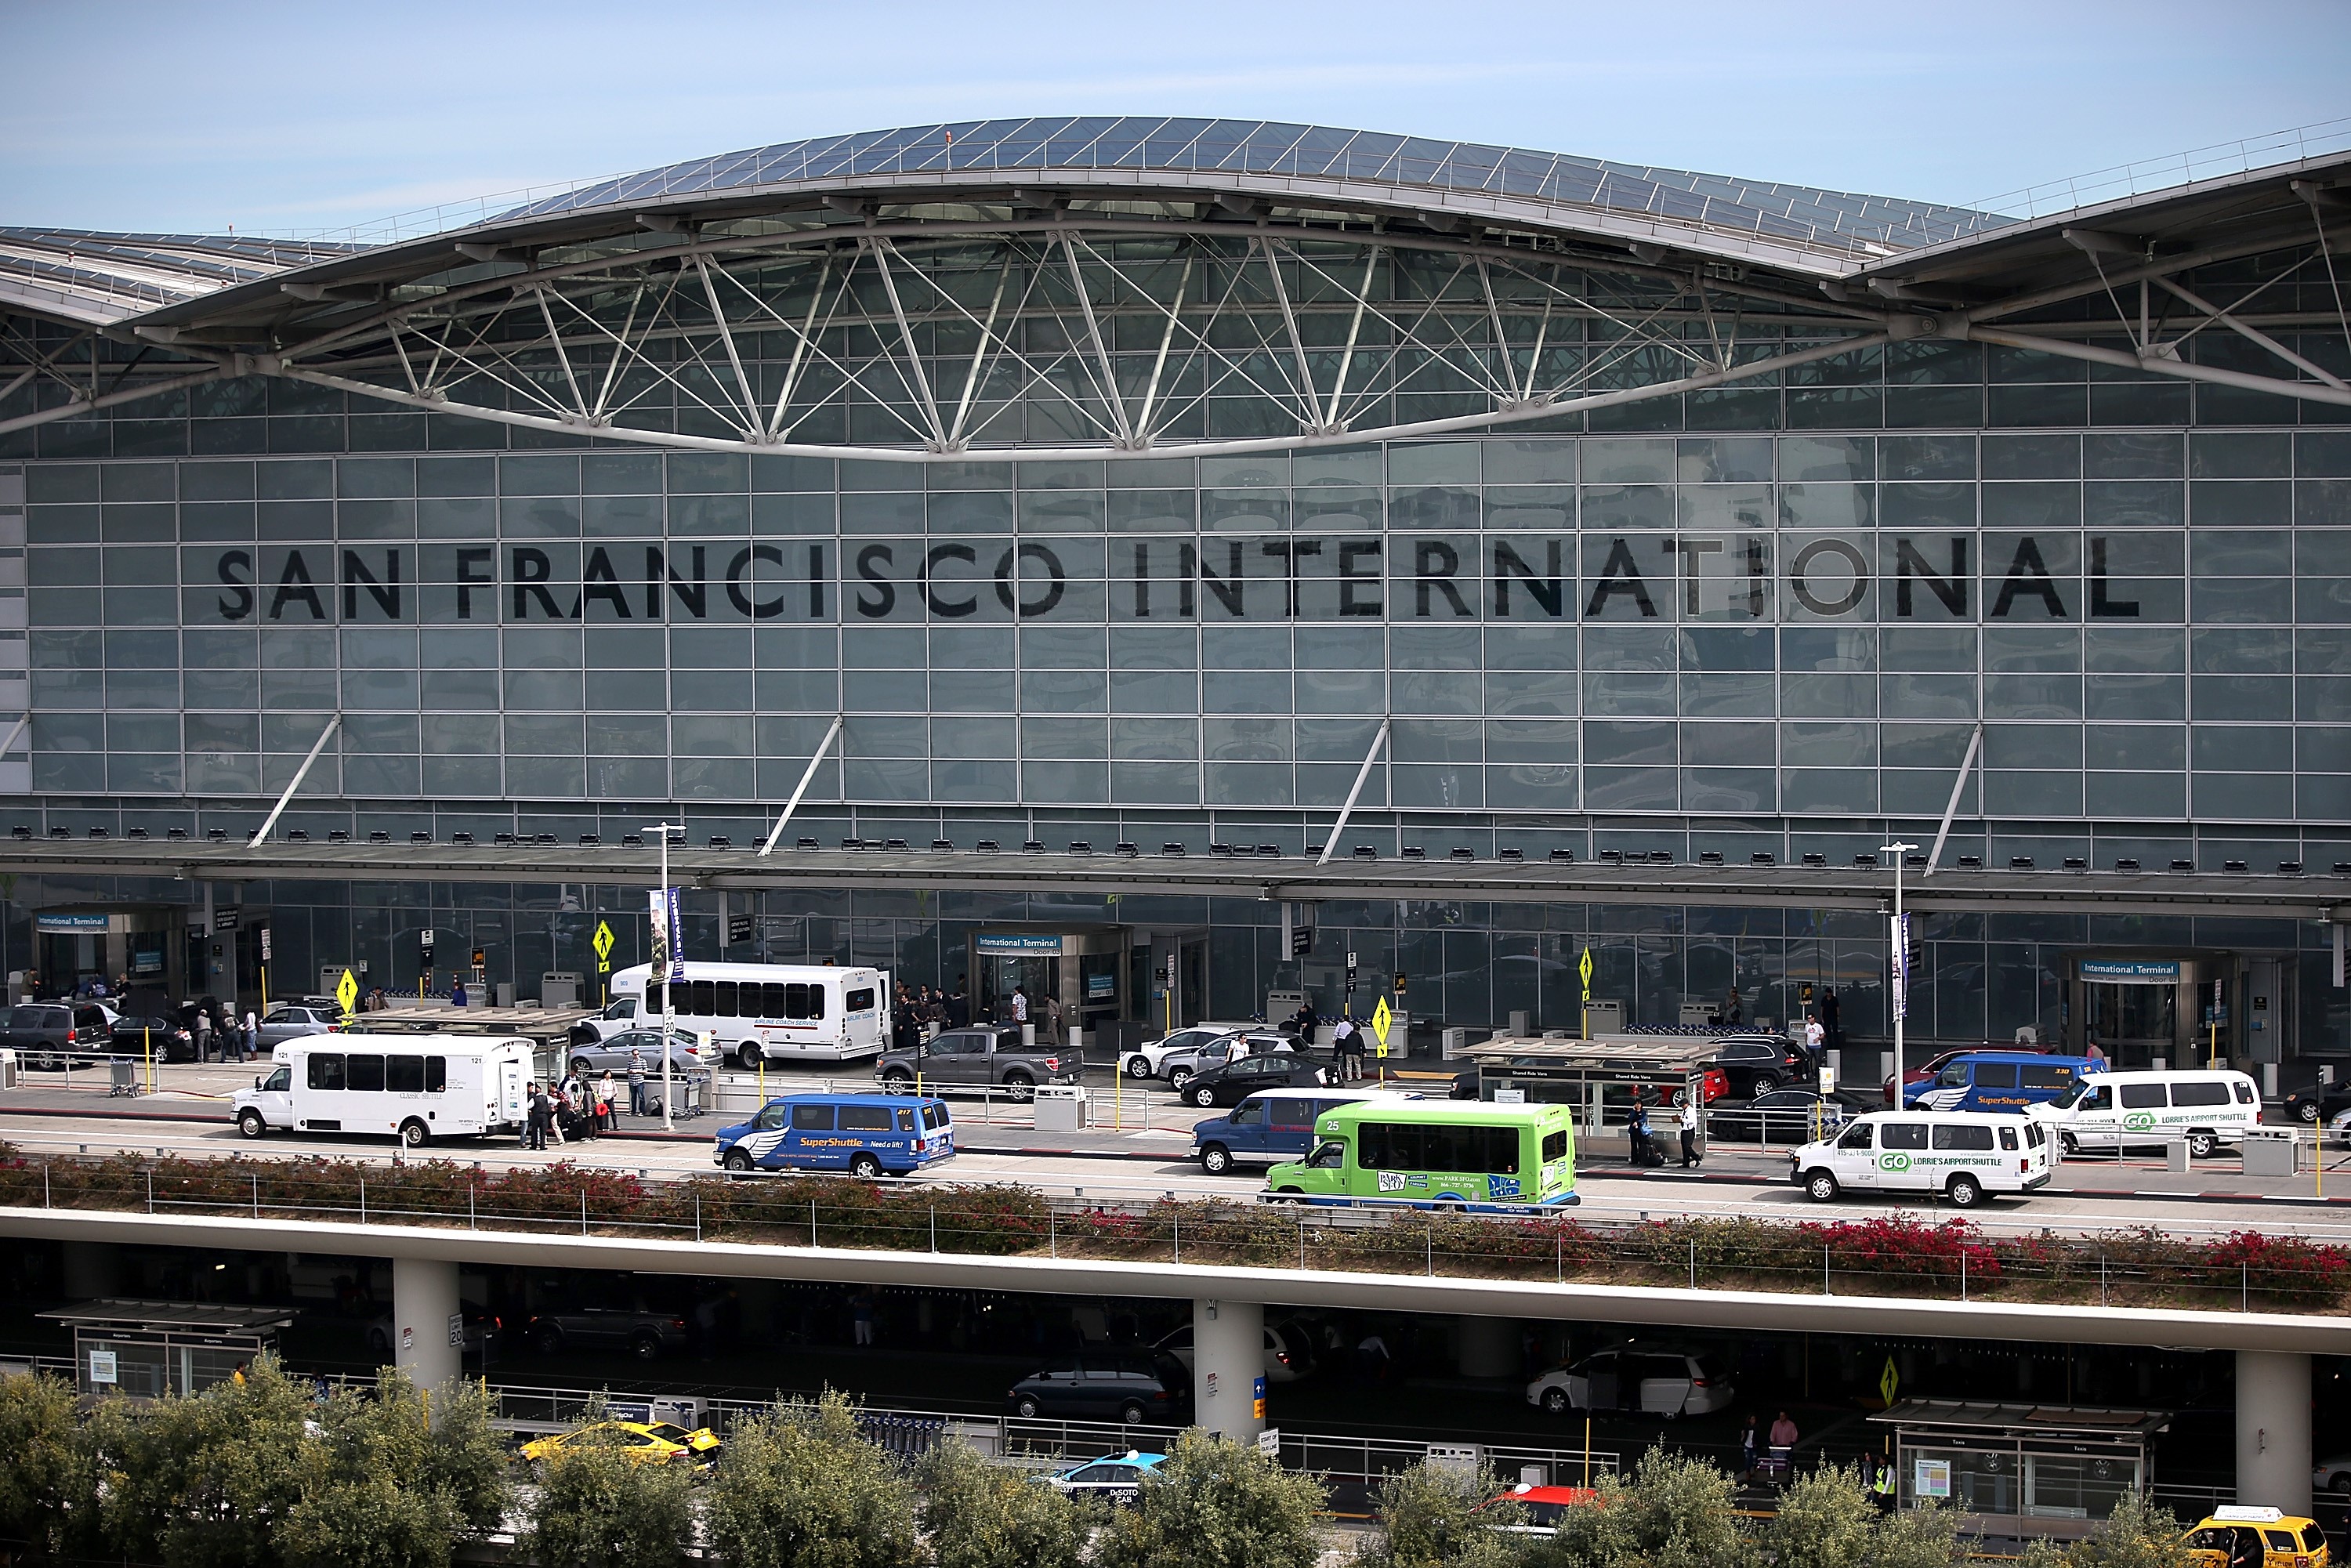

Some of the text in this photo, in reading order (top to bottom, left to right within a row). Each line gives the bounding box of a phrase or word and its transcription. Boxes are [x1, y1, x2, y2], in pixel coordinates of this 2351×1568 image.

[217, 537, 2140, 621] SAN FRANCISCO INTERNATIONAL
[980, 938, 1020, 947] International
[2085, 964, 2133, 973] International
[665, 1022, 675, 1033] 20
[1978, 1096, 2030, 1106] SuperShuttle
[2162, 1115, 2190, 1124] LORRIE'S
[1326, 1121, 1339, 1131] 25
[800, 1138, 863, 1148] SuperShuttle
[1881, 1154, 1908, 1170] GO
[1380, 1174, 1403, 1184] PARK
[1382, 1180, 1400, 1190] SFO
[451, 1330, 462, 1343] 20
